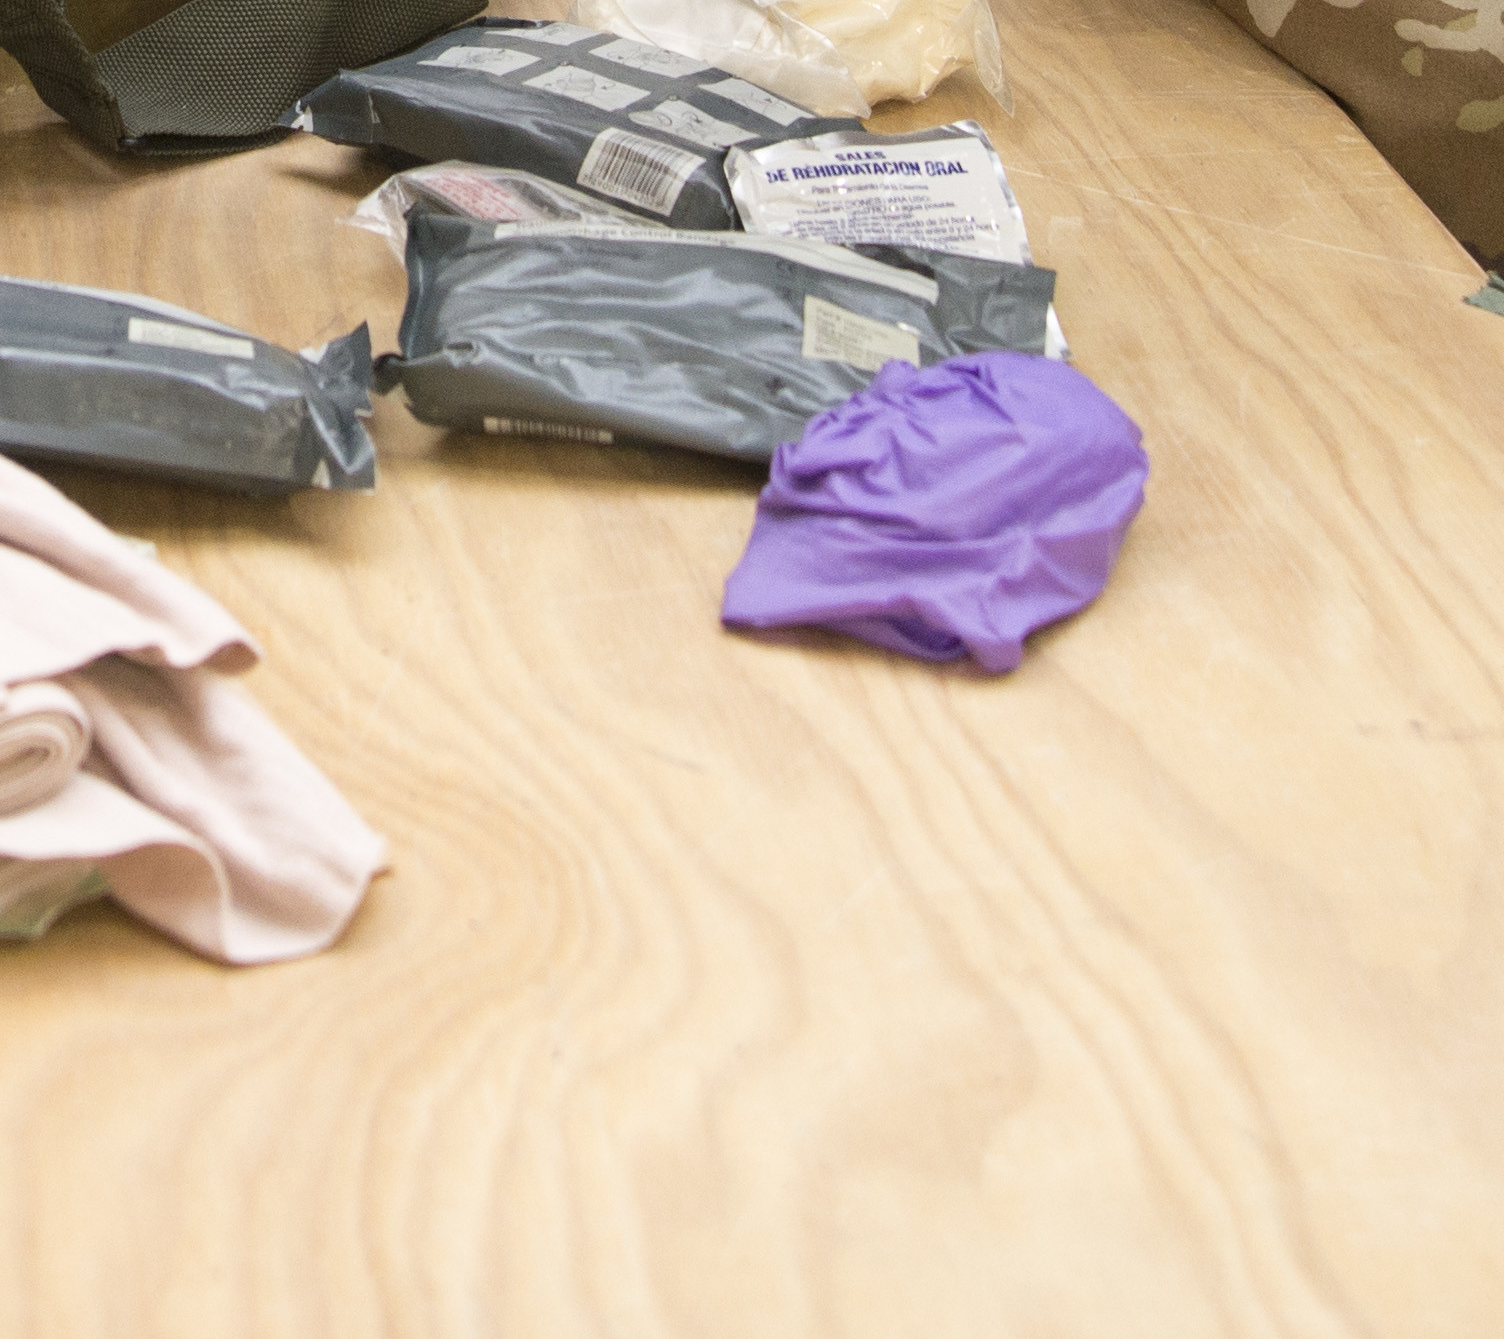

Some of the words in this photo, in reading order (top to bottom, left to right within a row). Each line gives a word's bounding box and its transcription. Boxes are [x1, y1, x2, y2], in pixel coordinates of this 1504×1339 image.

[835, 150, 886, 162] SALES
[766, 168, 790, 183] DE
[924, 160, 968, 177] ORAL
